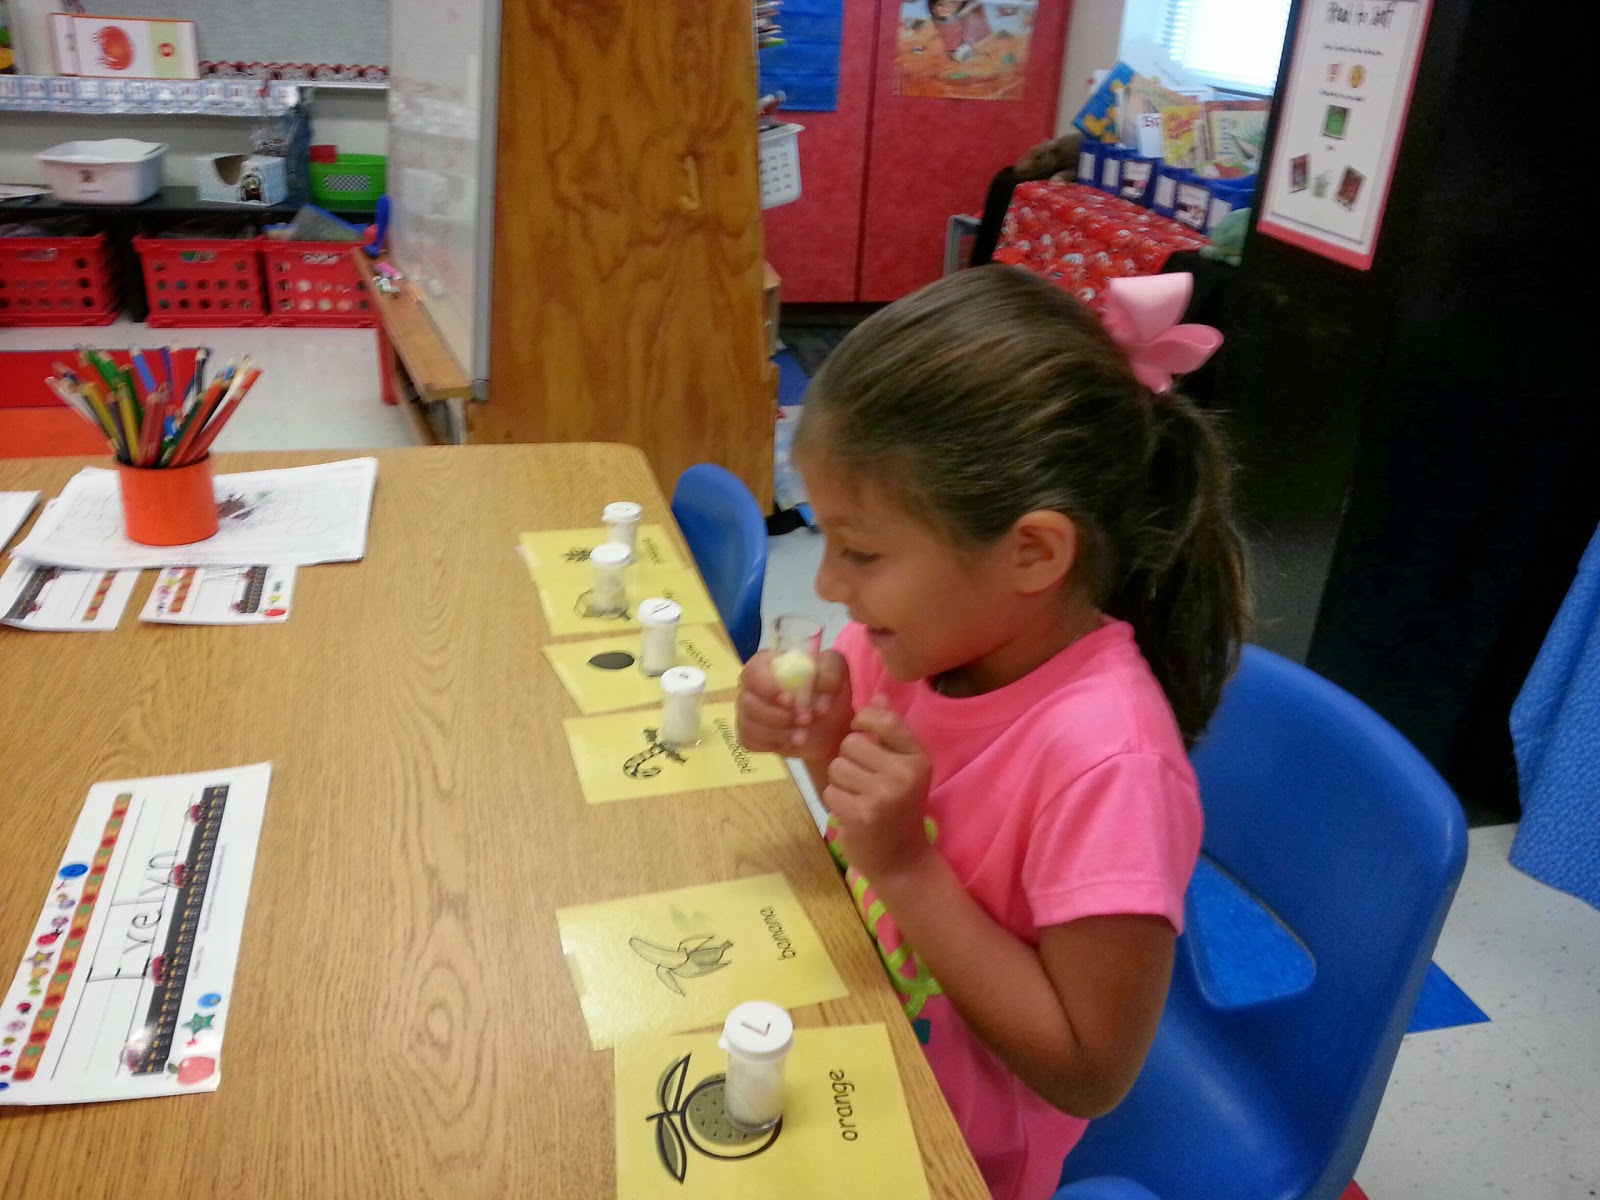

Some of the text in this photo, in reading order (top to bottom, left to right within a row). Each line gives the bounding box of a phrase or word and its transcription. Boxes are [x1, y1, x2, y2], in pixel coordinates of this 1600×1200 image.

[86, 849, 179, 983] Evelyn
[760, 905, 796, 961] banana
[829, 1066, 858, 1142] orange
